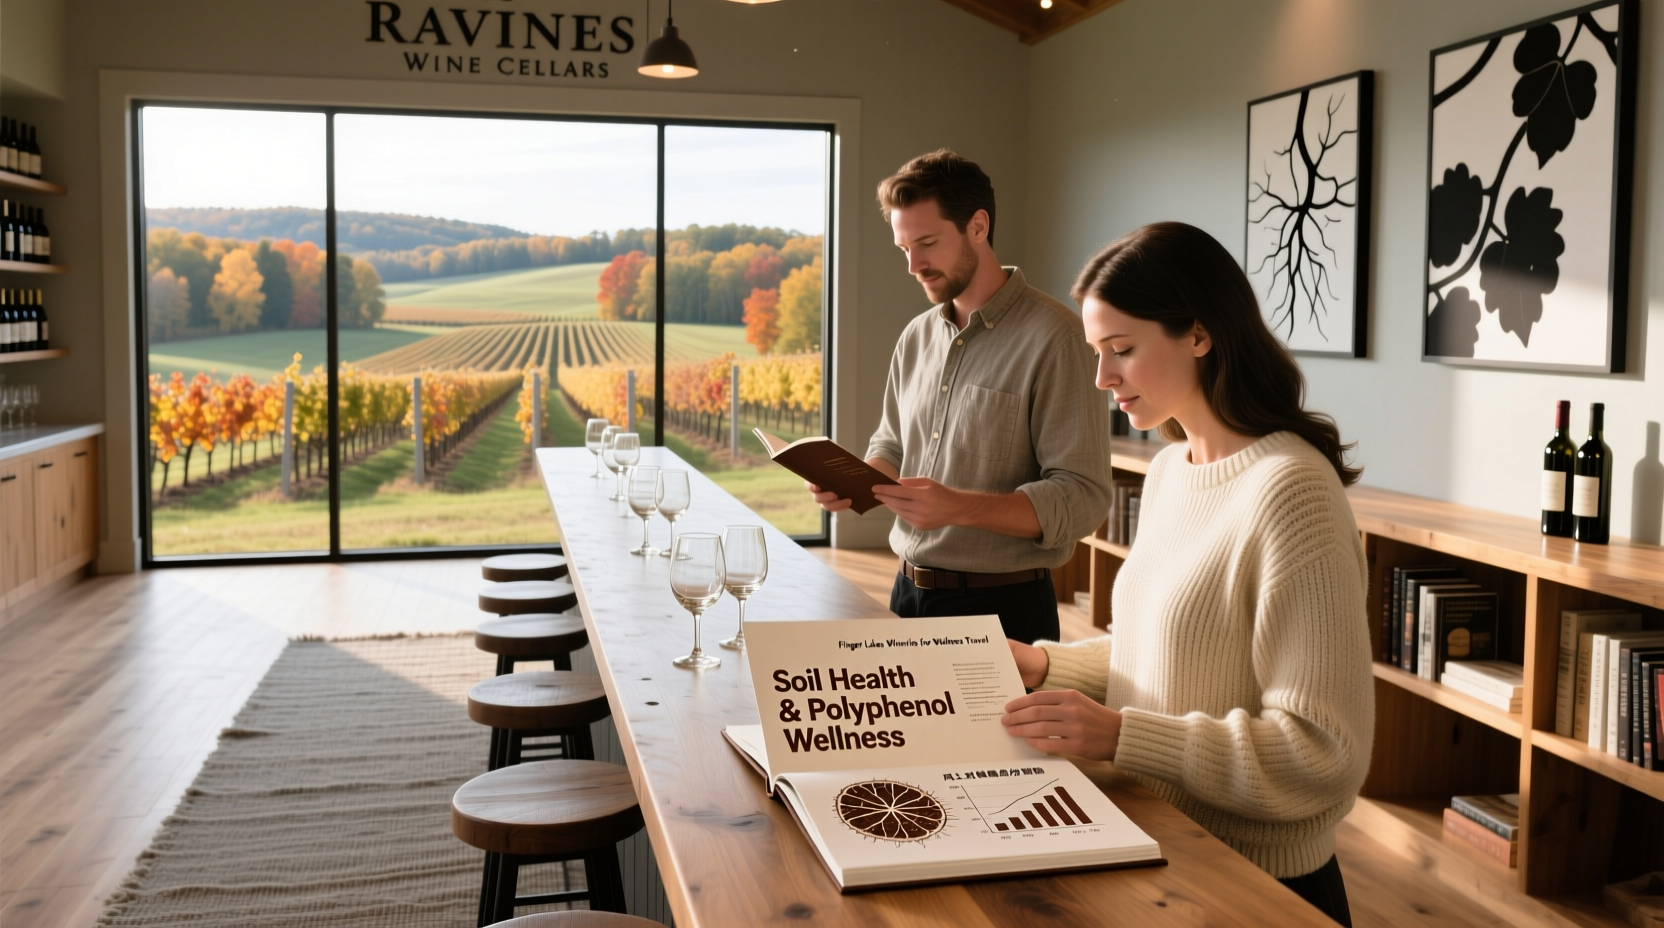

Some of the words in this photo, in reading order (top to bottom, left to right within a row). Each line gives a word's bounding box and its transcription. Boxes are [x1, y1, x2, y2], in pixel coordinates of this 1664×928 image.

[366, 1, 635, 54] RAVINES
[403, 52, 481, 73] WINE
[497, 57, 609, 78] CELLARS
[772, 668, 823, 692] Soil
[828, 665, 915, 691] Health
[779, 699, 802, 722] &
[807, 691, 955, 726] Polyphenol
[783, 725, 906, 753] Wellness
